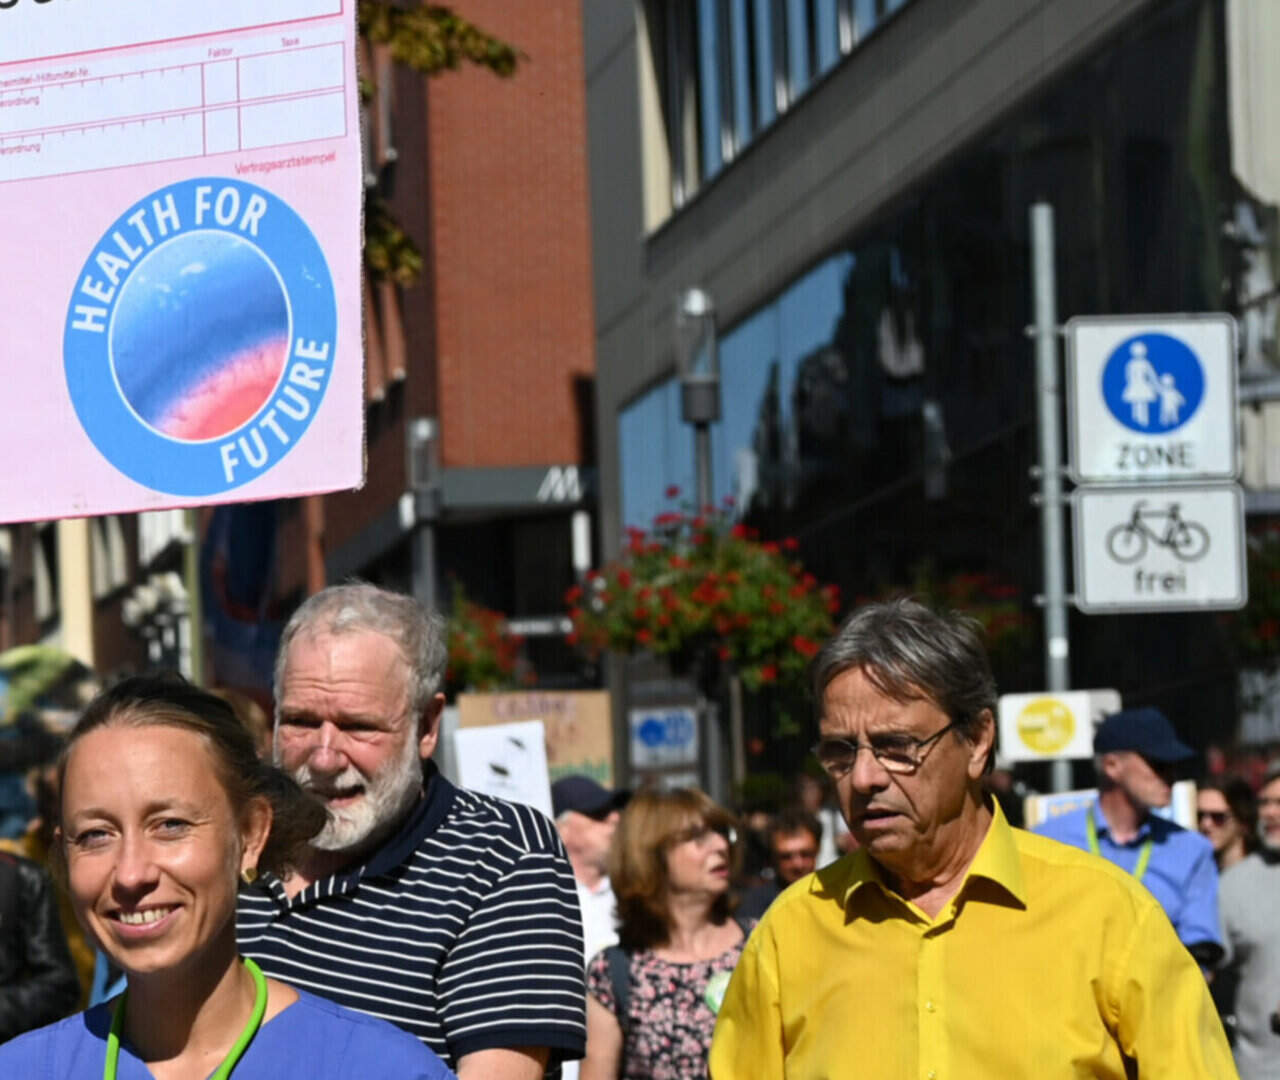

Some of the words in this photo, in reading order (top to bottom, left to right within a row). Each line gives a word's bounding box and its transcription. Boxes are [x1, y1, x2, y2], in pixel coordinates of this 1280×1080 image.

[71, 193, 182, 333] HEALTH
[195, 186, 268, 236] FOR
[220, 337, 329, 483] FUTURE
[1116, 443, 1195, 469] ZONE
[1135, 568, 1187, 593] frei
